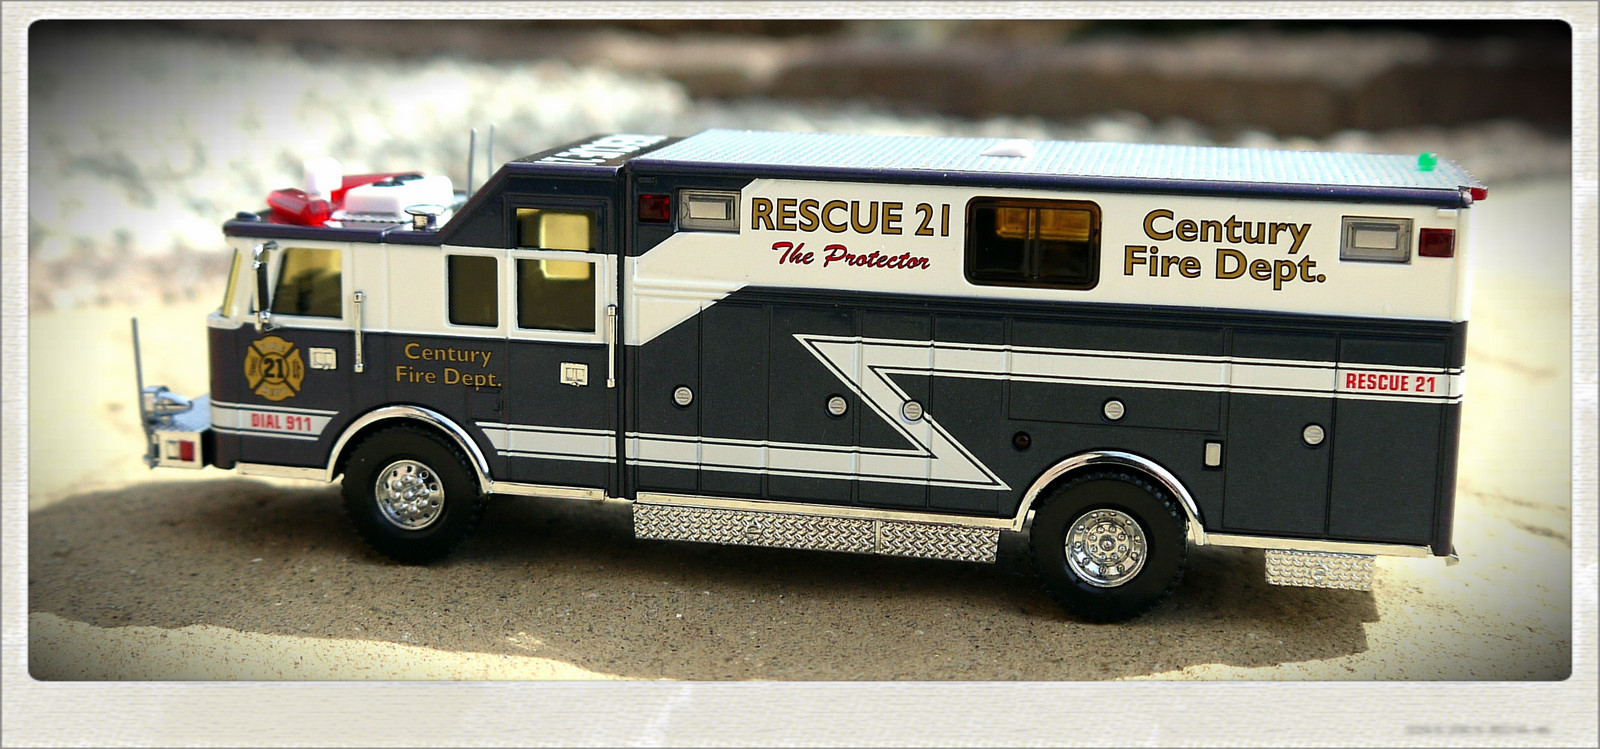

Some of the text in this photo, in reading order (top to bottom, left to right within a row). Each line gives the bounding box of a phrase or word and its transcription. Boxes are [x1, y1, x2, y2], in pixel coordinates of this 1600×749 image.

[751, 197, 951, 237] RESCUE 21
[1143, 209, 1311, 254] Century
[772, 241, 931, 270] The Protector
[1124, 245, 1327, 291] Fire Dept.
[263, 357, 284, 379] 21
[404, 342, 491, 368] Century
[395, 365, 502, 391] Fire Dept.
[1346, 373, 1436, 393] RESCUE 21
[251, 413, 312, 431] DIAL 911
